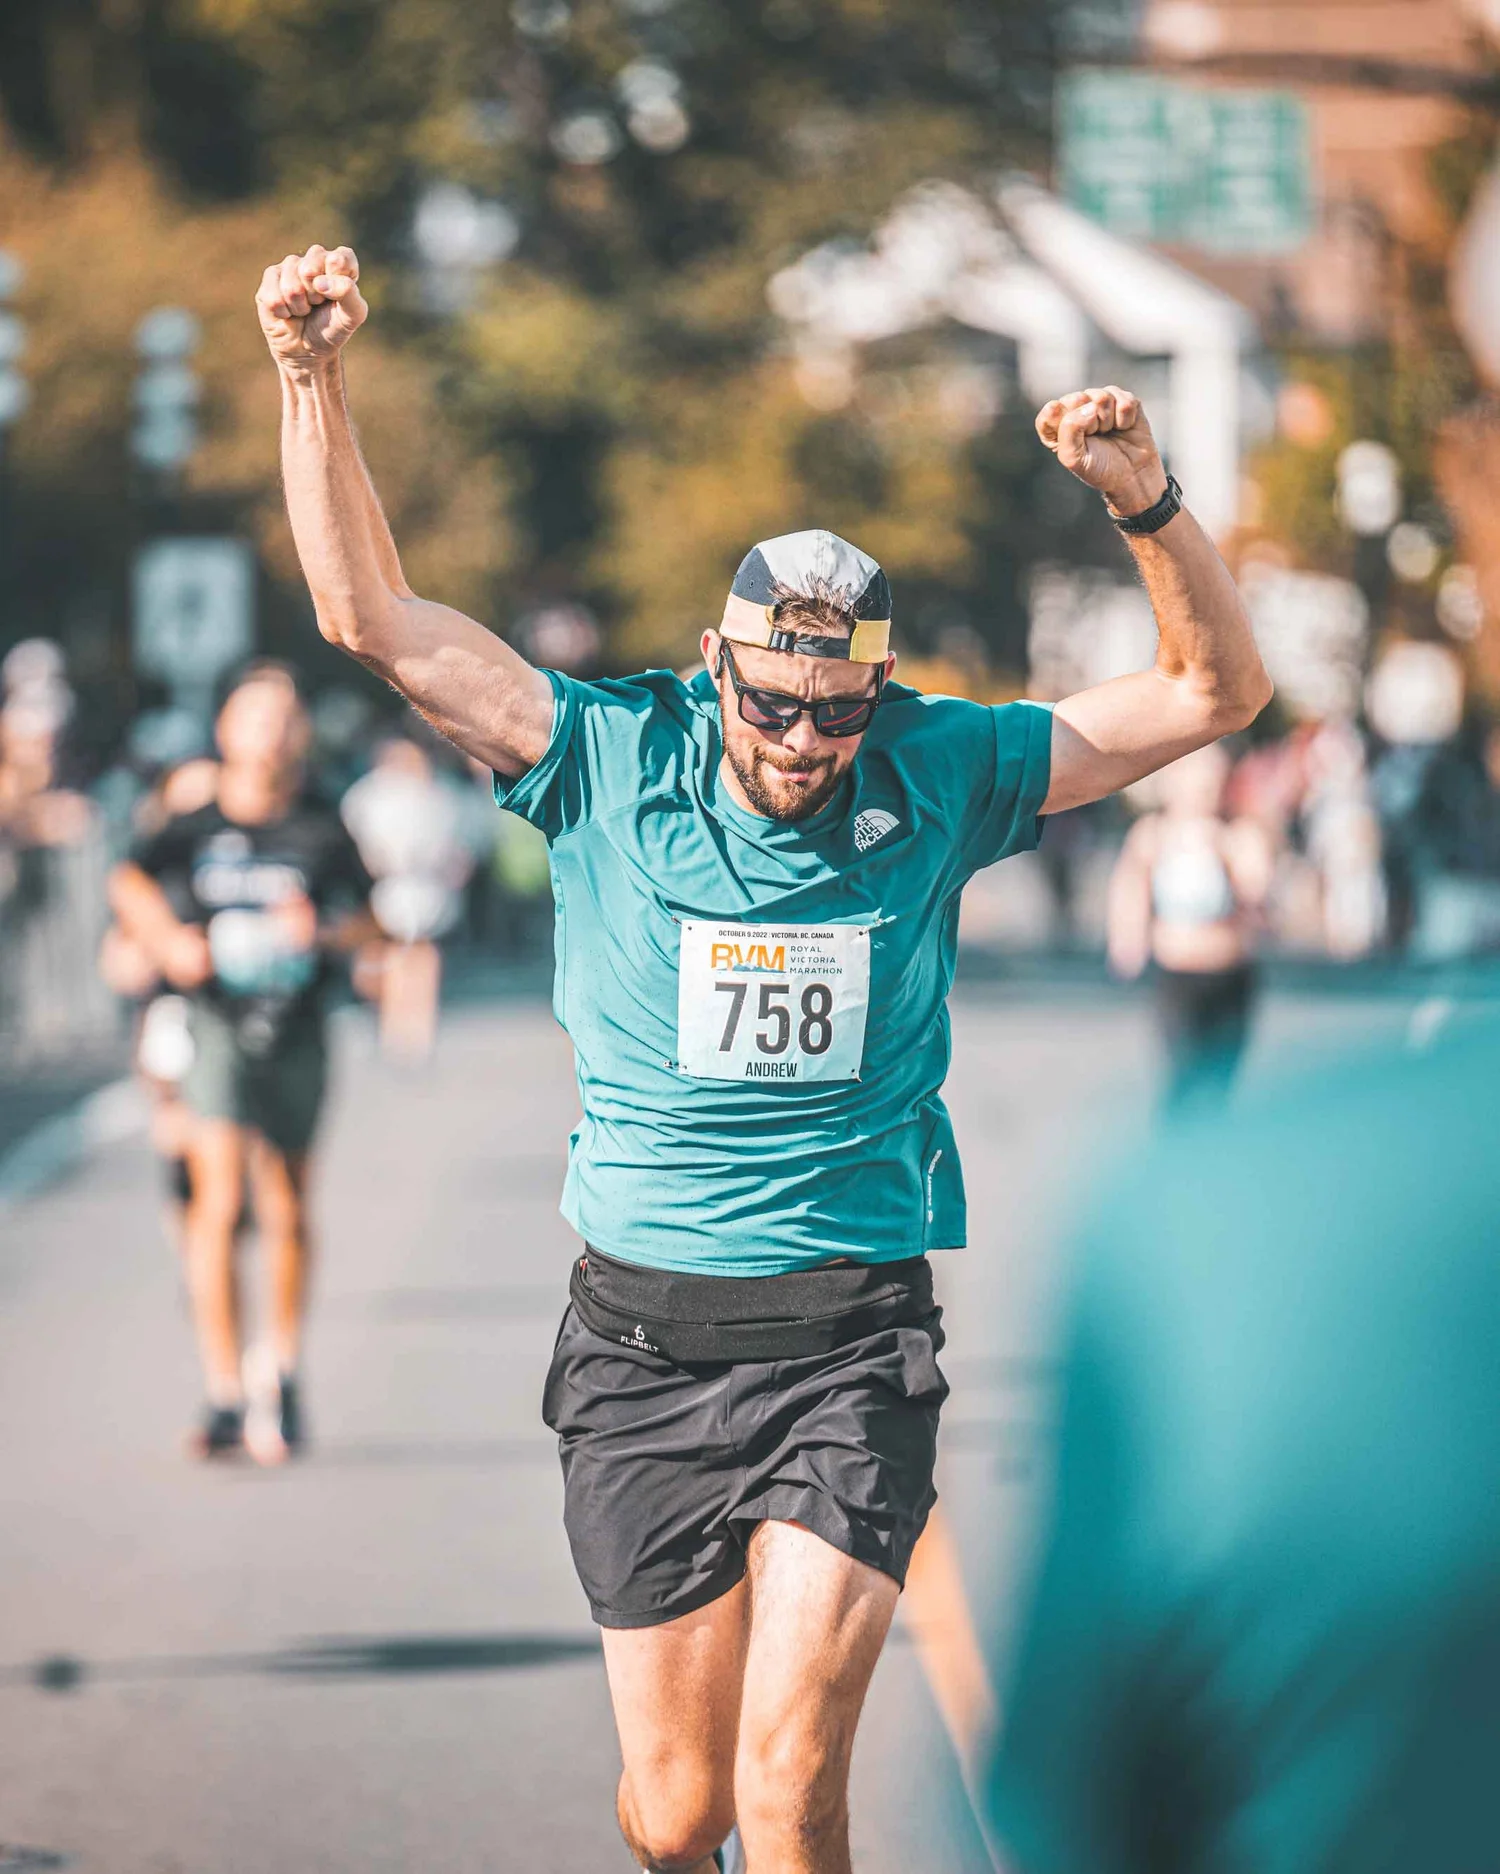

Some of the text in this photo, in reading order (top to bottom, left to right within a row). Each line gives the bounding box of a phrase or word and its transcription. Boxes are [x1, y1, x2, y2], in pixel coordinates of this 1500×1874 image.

[855, 828, 883, 852] FACE
[718, 930, 746, 938] OCTOBER
[790, 945, 822, 953] ROYAL
[710, 943, 785, 971] RVM
[790, 956, 836, 964] VICTORIA
[789, 967, 843, 975] MARATHON
[714, 981, 833, 1055] 758
[745, 1062, 797, 1077] ANDREW
[620, 1335, 659, 1352] FLIPBELT
